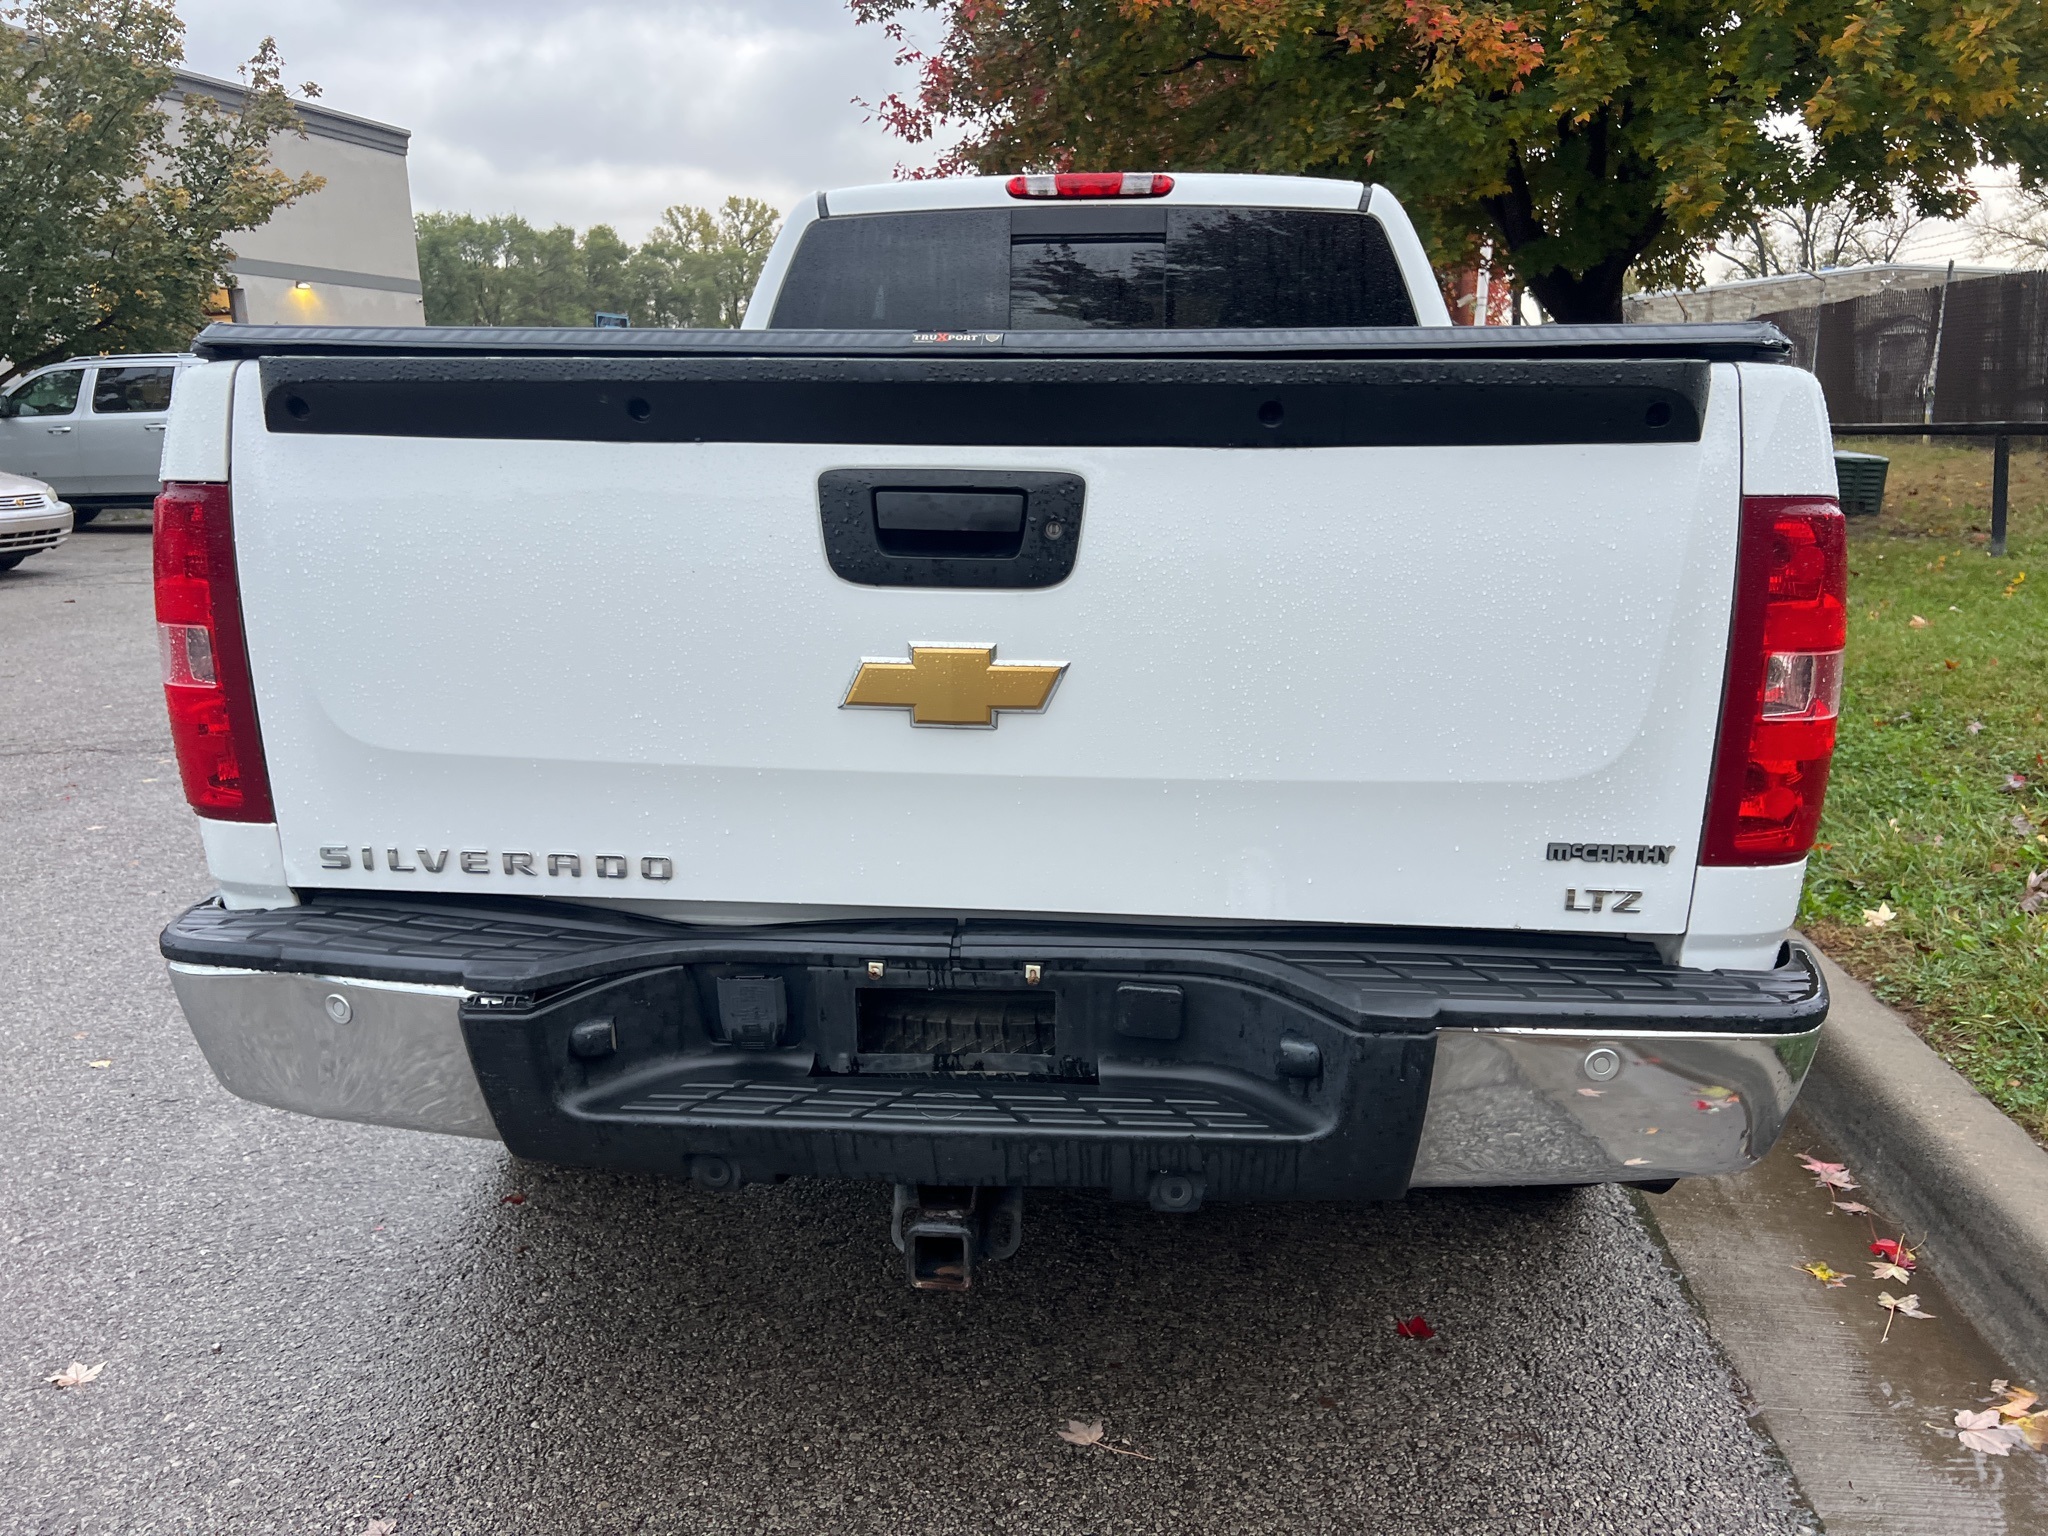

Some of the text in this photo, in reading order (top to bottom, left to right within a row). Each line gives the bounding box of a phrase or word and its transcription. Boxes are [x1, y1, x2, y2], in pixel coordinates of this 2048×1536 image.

[913, 332, 978, 342] TRUXPORT
[319, 845, 673, 880] SILVERADO
[1565, 887, 1643, 913] LTZ
